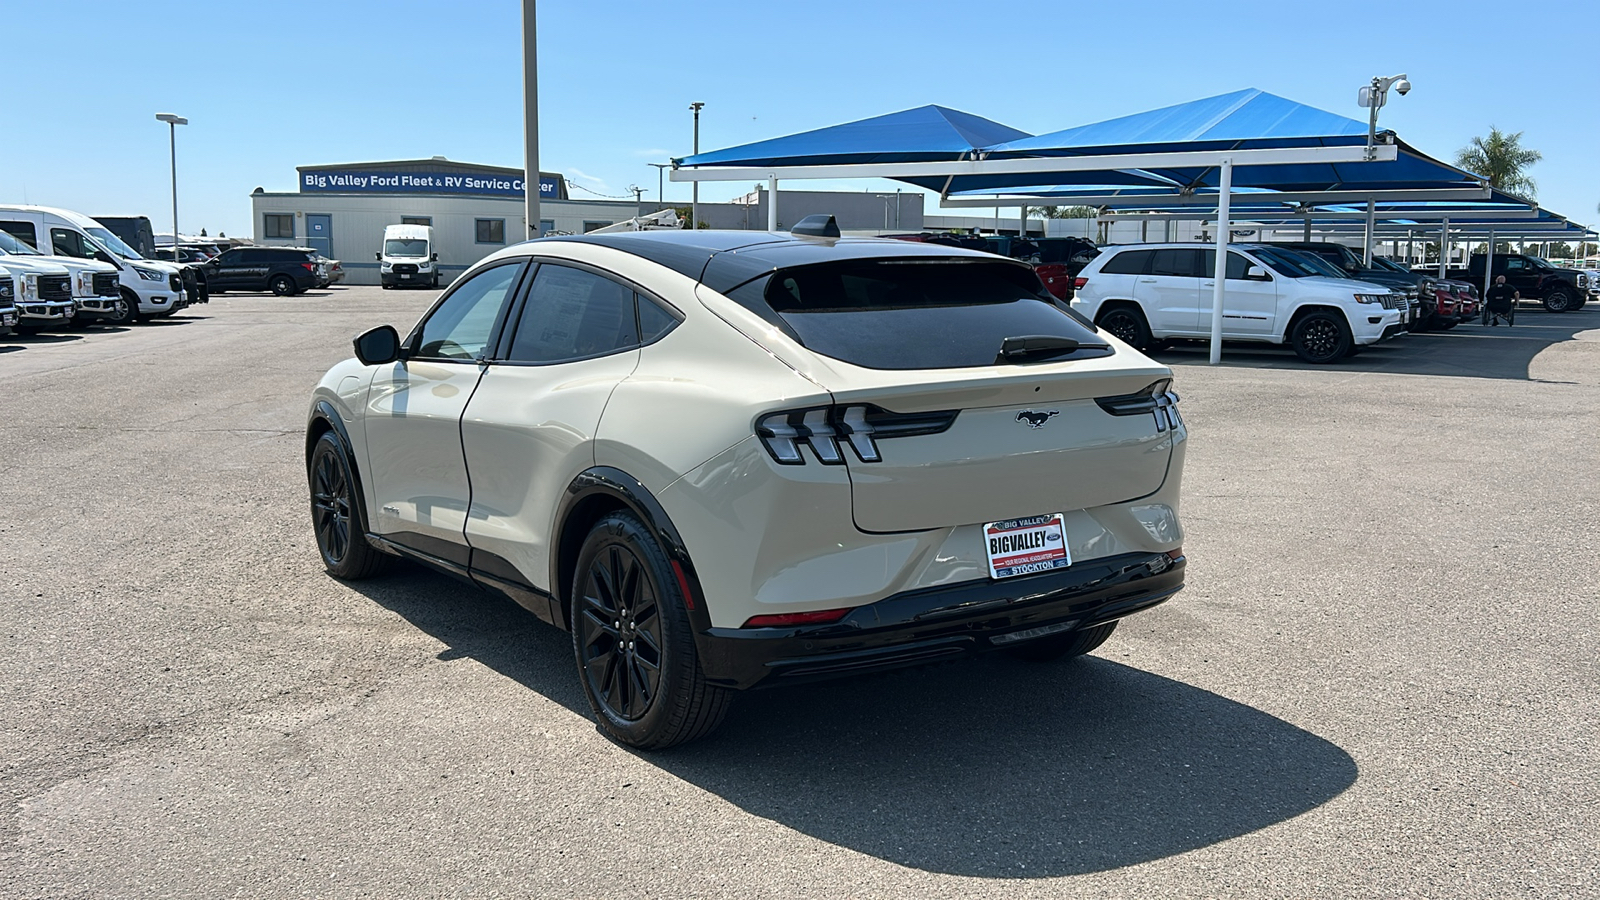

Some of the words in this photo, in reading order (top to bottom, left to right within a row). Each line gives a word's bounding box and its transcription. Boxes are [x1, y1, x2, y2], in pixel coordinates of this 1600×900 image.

[305, 175, 326, 187] Big
[328, 175, 368, 187] Valley
[370, 175, 399, 186] Ford
[401, 175, 433, 186] Fleet
[435, 179, 443, 187] &
[445, 177, 462, 187] RV
[465, 178, 510, 189] Service
[512, 180, 553, 192] Ceer
[1004, 521, 1017, 529] BIG
[1019, 517, 1045, 527] VALLEY
[990, 531, 1046, 555] BIGVALLEY
[1011, 561, 1053, 575] STOCKTON
